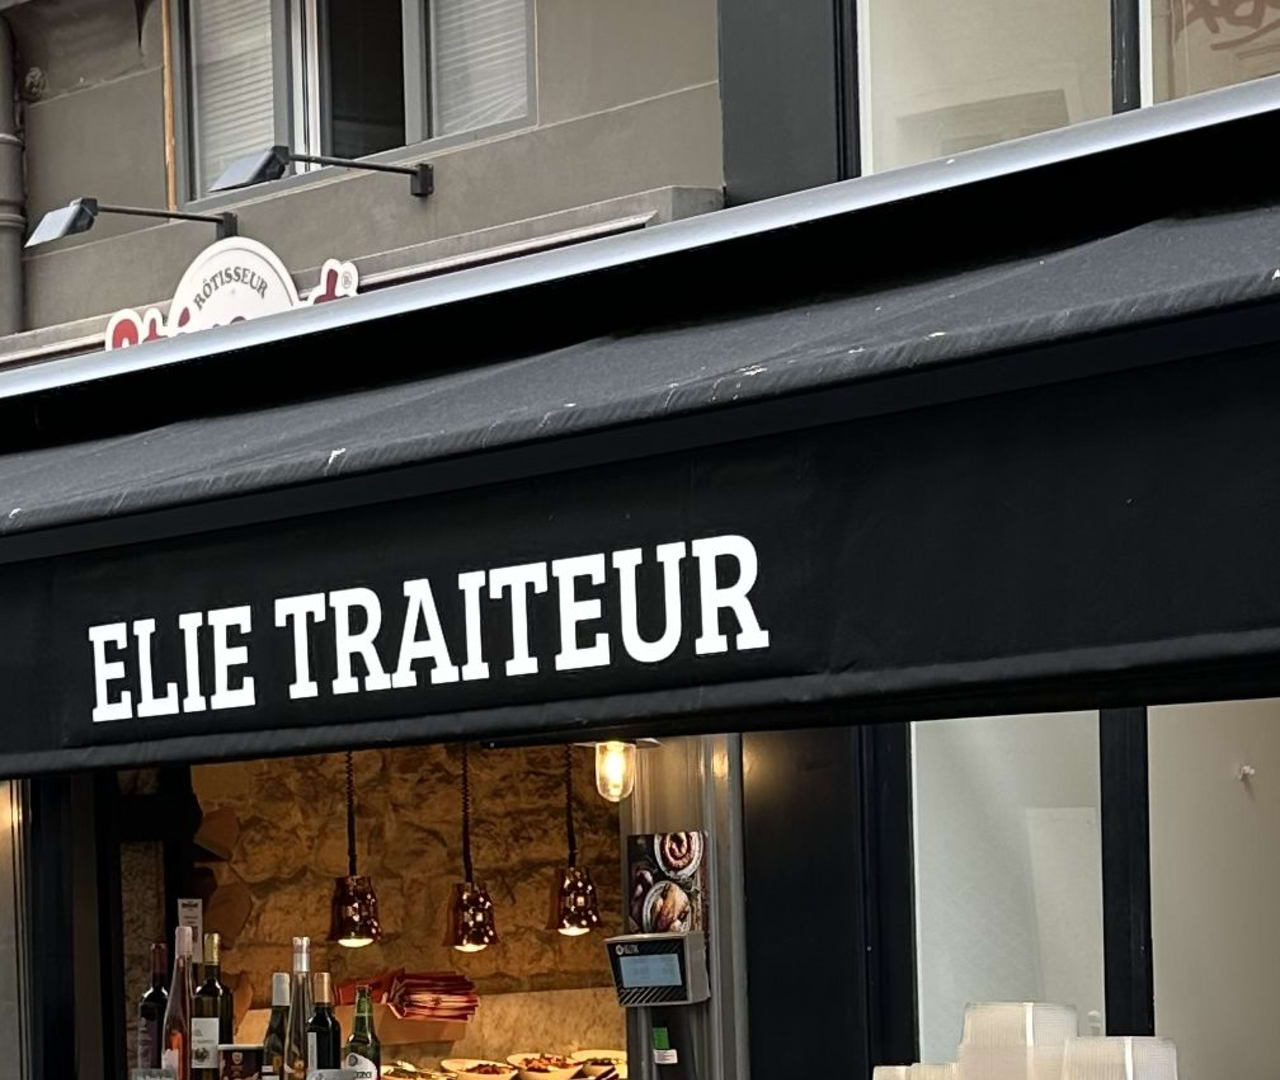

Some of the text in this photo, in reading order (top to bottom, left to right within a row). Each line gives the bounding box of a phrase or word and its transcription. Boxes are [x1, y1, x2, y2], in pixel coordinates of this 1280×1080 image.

[192, 266, 268, 311] RÔTISSEUR
[88, 534, 770, 723] ELIE TRAITEUR
